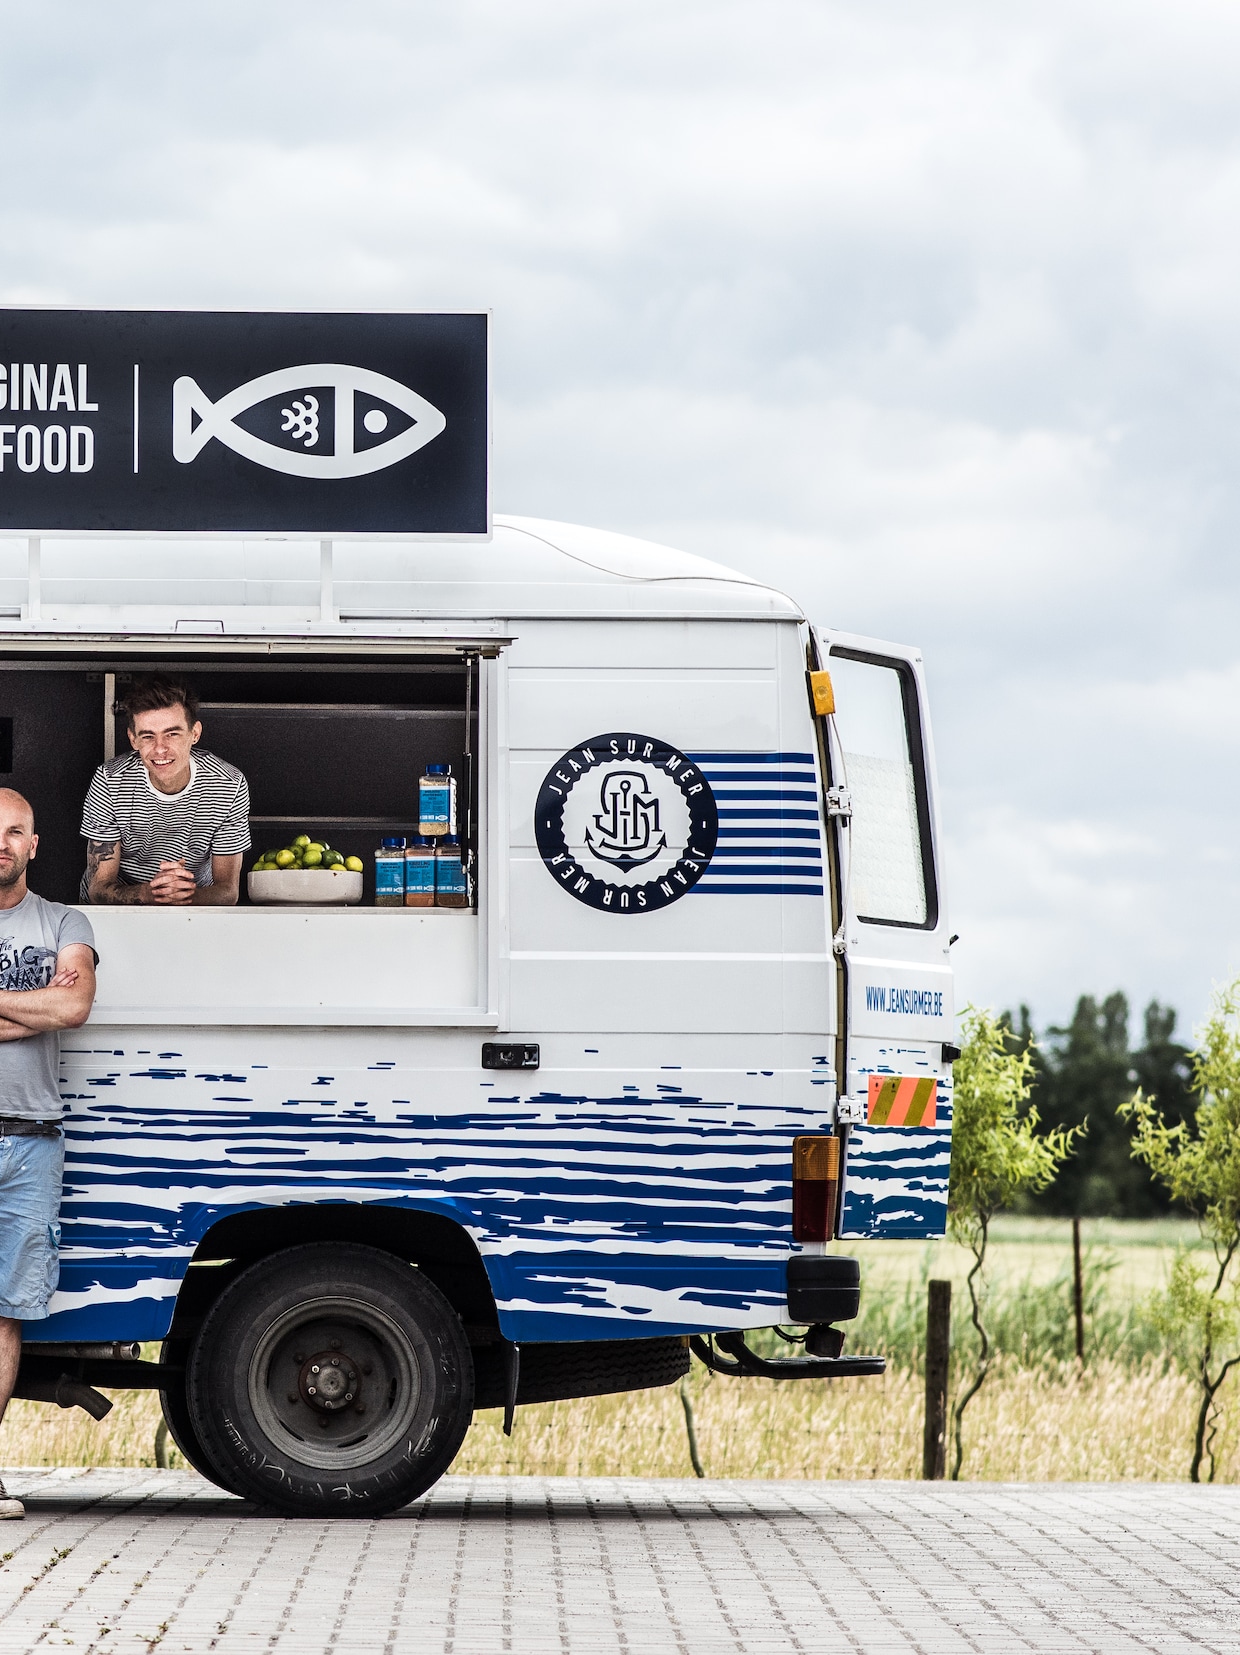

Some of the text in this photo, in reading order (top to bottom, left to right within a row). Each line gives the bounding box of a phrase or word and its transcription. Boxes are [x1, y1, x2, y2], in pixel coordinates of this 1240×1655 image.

[548, 739, 703, 796] JEAN SUR MER
[551, 847, 706, 908] JEAN SUR MER
[865, 986, 943, 1017] WWW.JEANSURMER.BE
